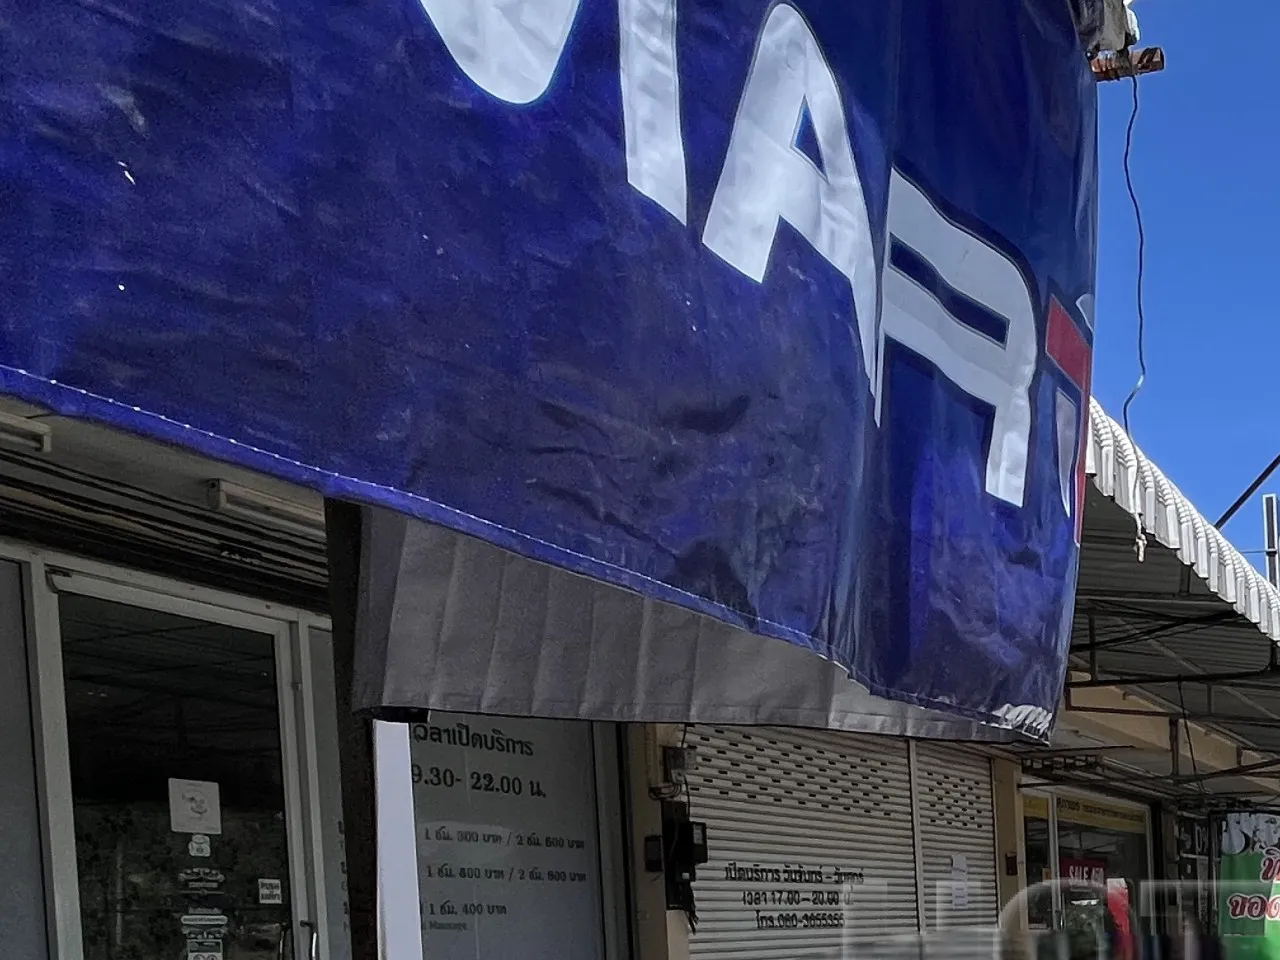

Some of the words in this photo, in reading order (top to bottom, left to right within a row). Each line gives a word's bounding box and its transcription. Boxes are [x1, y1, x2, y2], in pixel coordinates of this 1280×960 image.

[412, 722, 534, 756] วลาเปิดบริการ
[470, 771, 522, 795] 22.00
